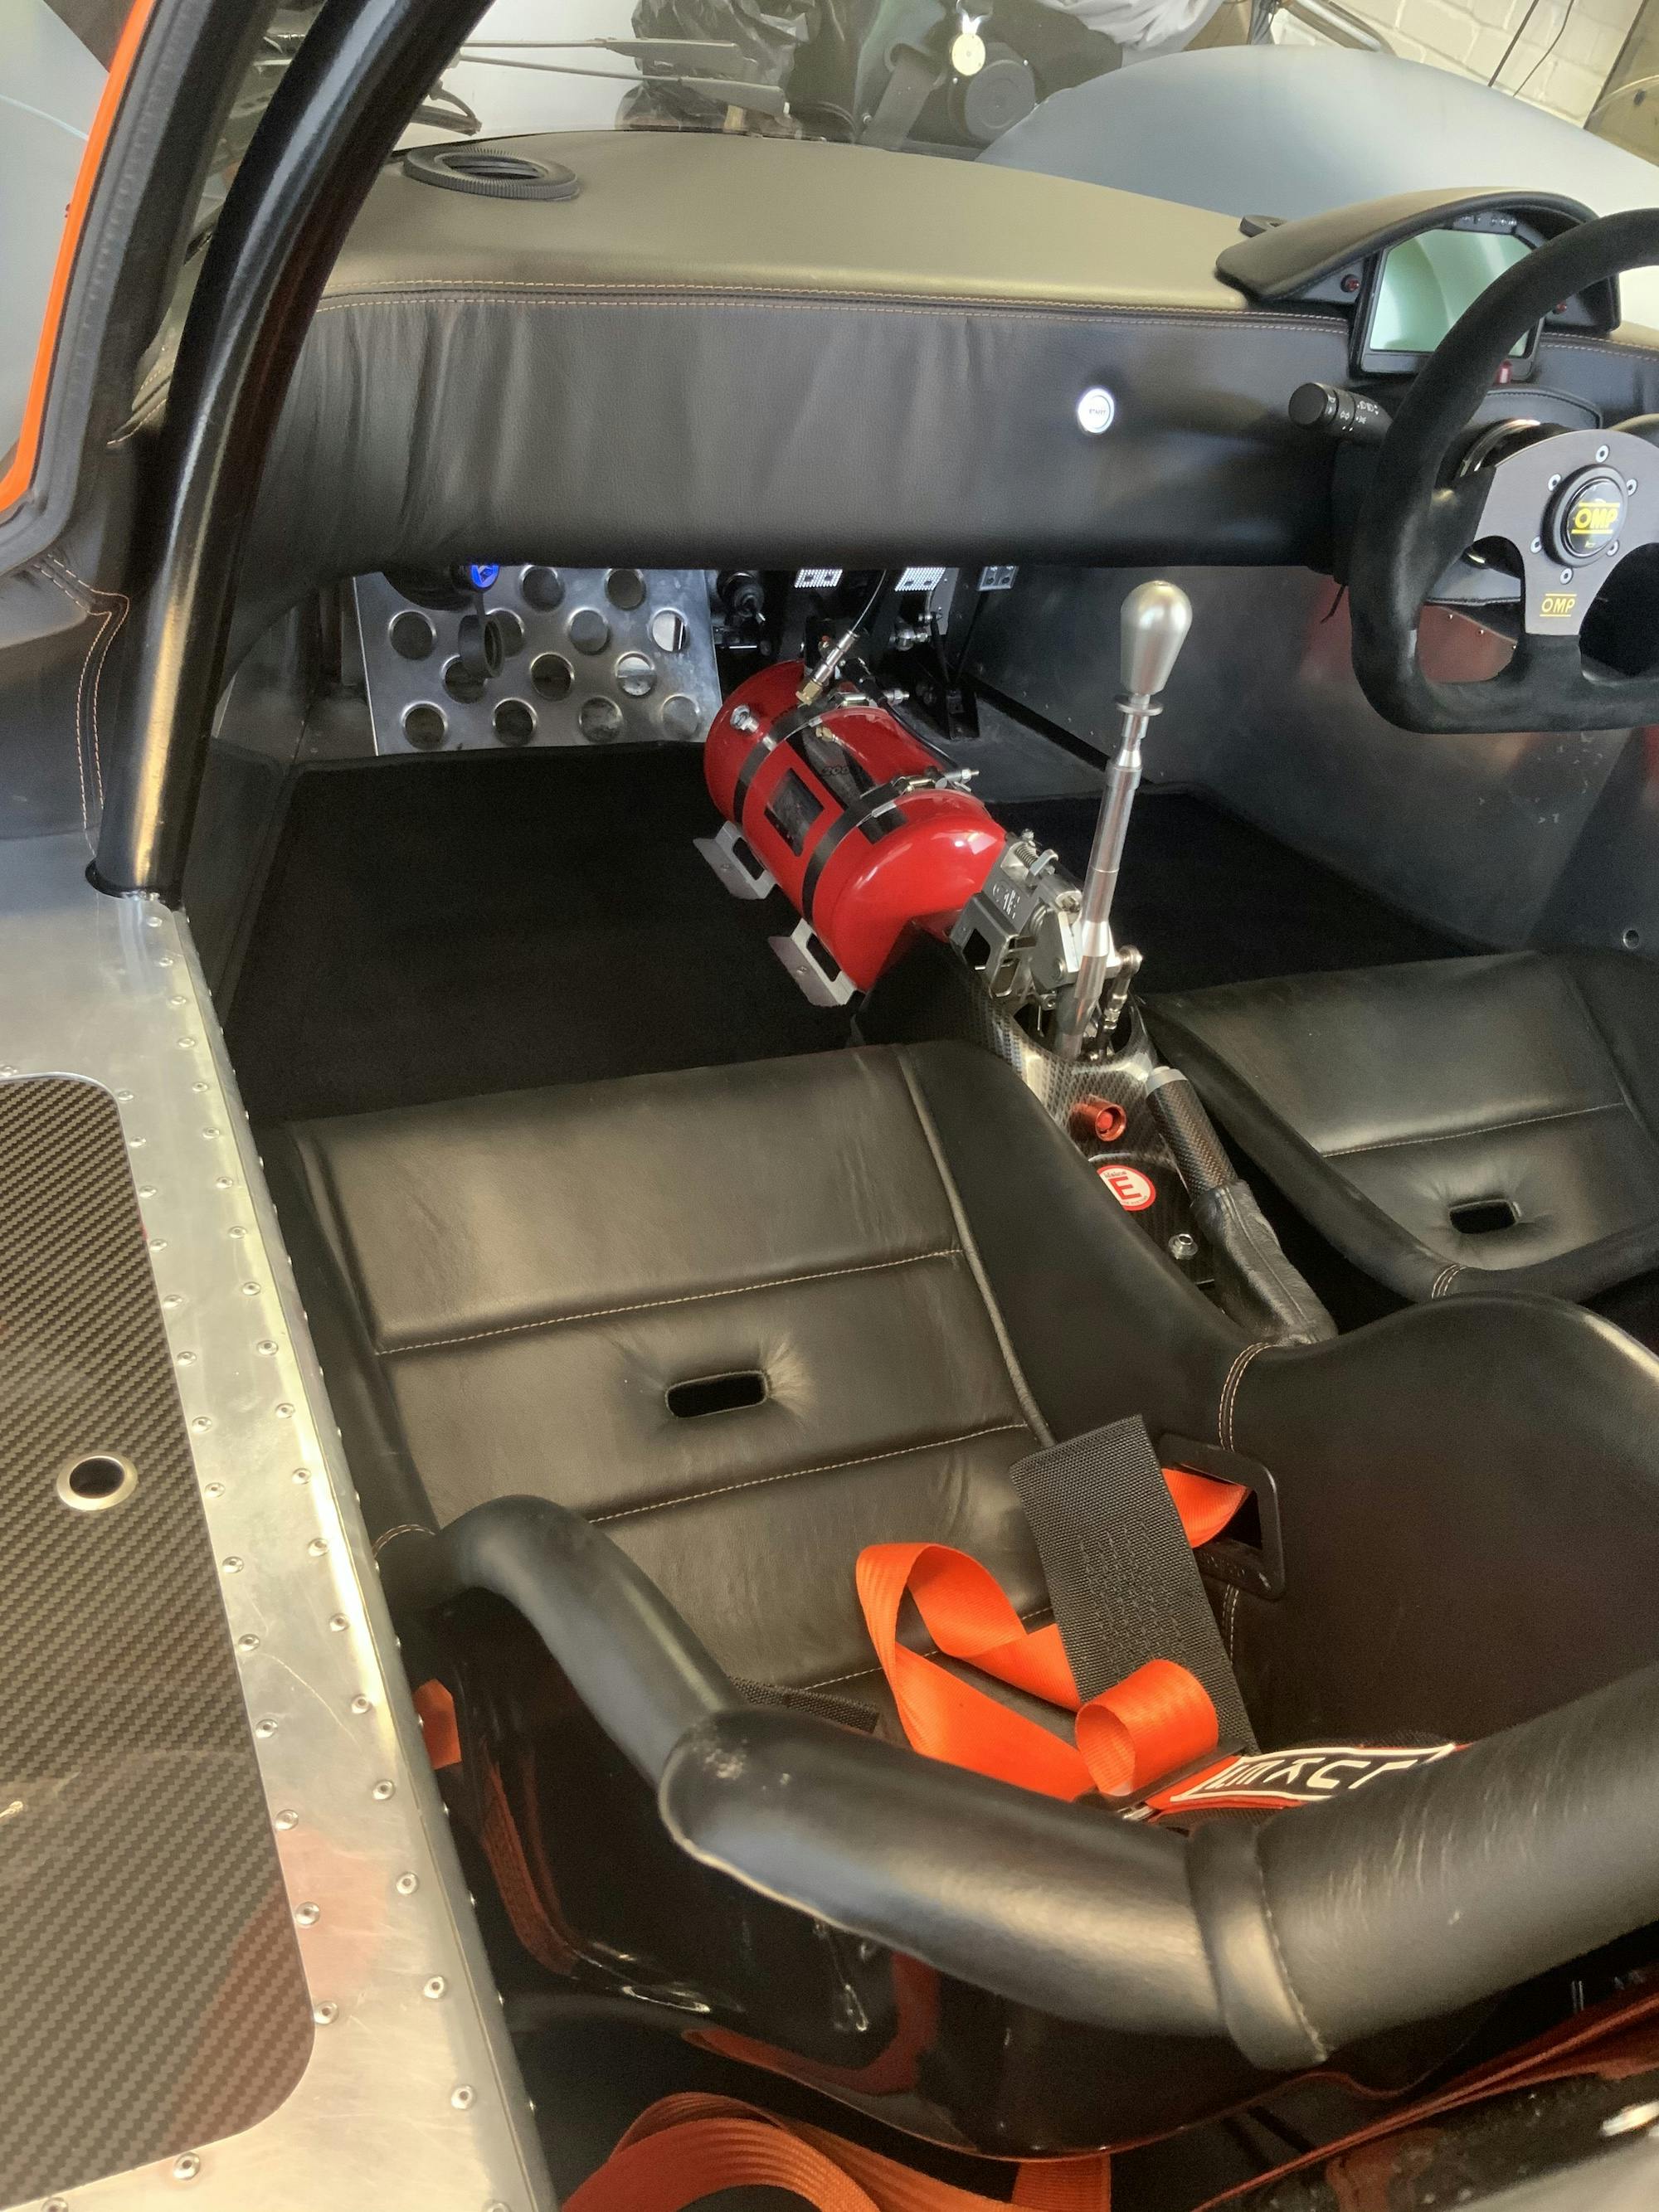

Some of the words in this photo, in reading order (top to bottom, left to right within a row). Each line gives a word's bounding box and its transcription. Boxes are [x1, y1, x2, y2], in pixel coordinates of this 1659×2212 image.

[1574, 508, 1618, 529] OMP
[1541, 597, 1575, 613] OMP
[1107, 1176, 1142, 1200] E
